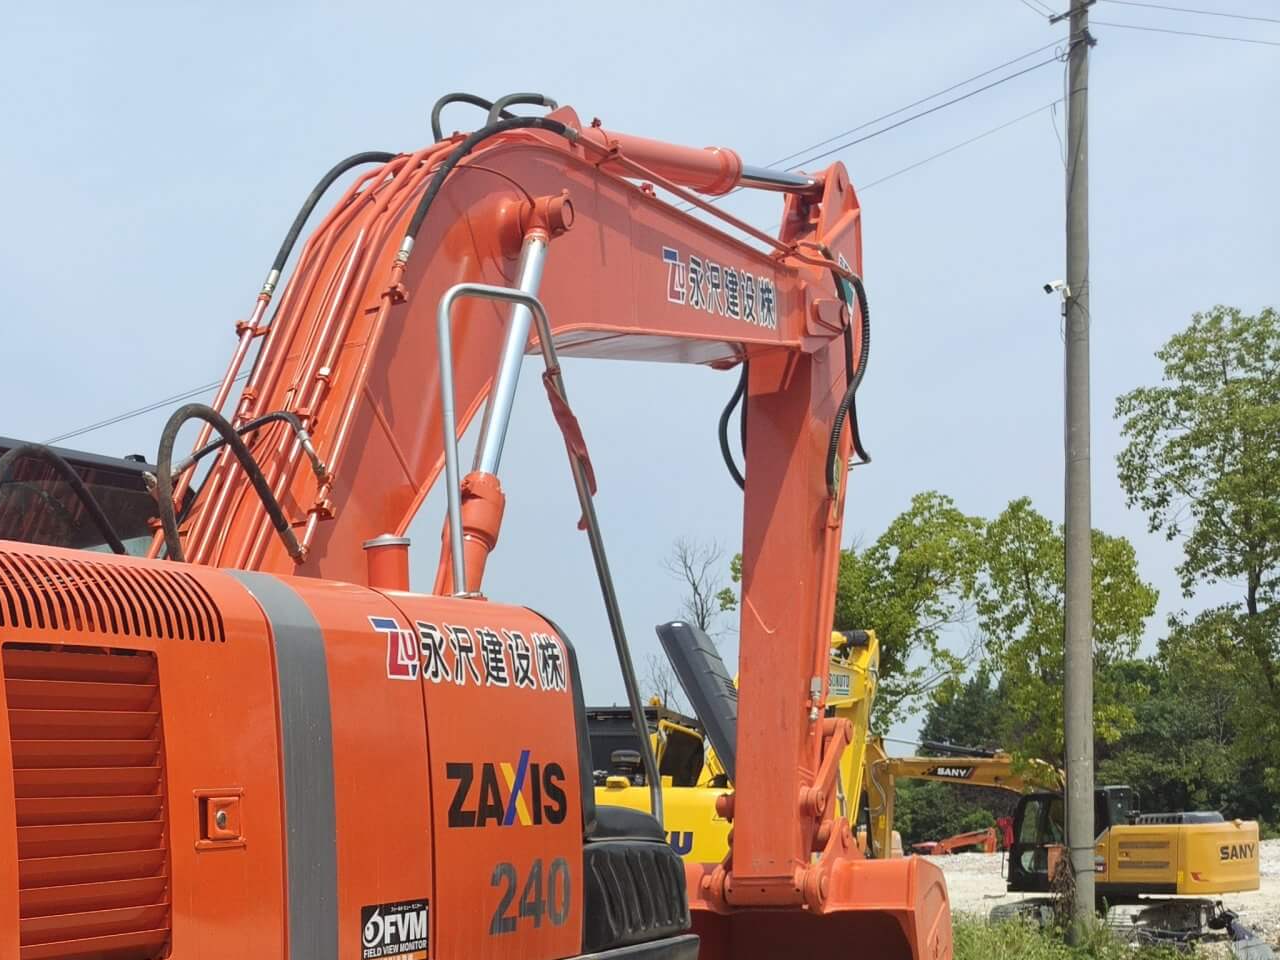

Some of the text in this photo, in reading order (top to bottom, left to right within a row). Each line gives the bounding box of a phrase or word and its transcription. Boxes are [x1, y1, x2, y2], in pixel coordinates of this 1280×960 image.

[937, 767, 966, 777] SANY
[446, 750, 567, 827] ZAXIS
[1220, 844, 1255, 860] SANY
[489, 858, 570, 935] 240
[384, 910, 427, 945] FVM
[363, 947, 382, 960] FIELD
[382, 943, 399, 955] VIEW
[400, 939, 427, 952] MONITOR
